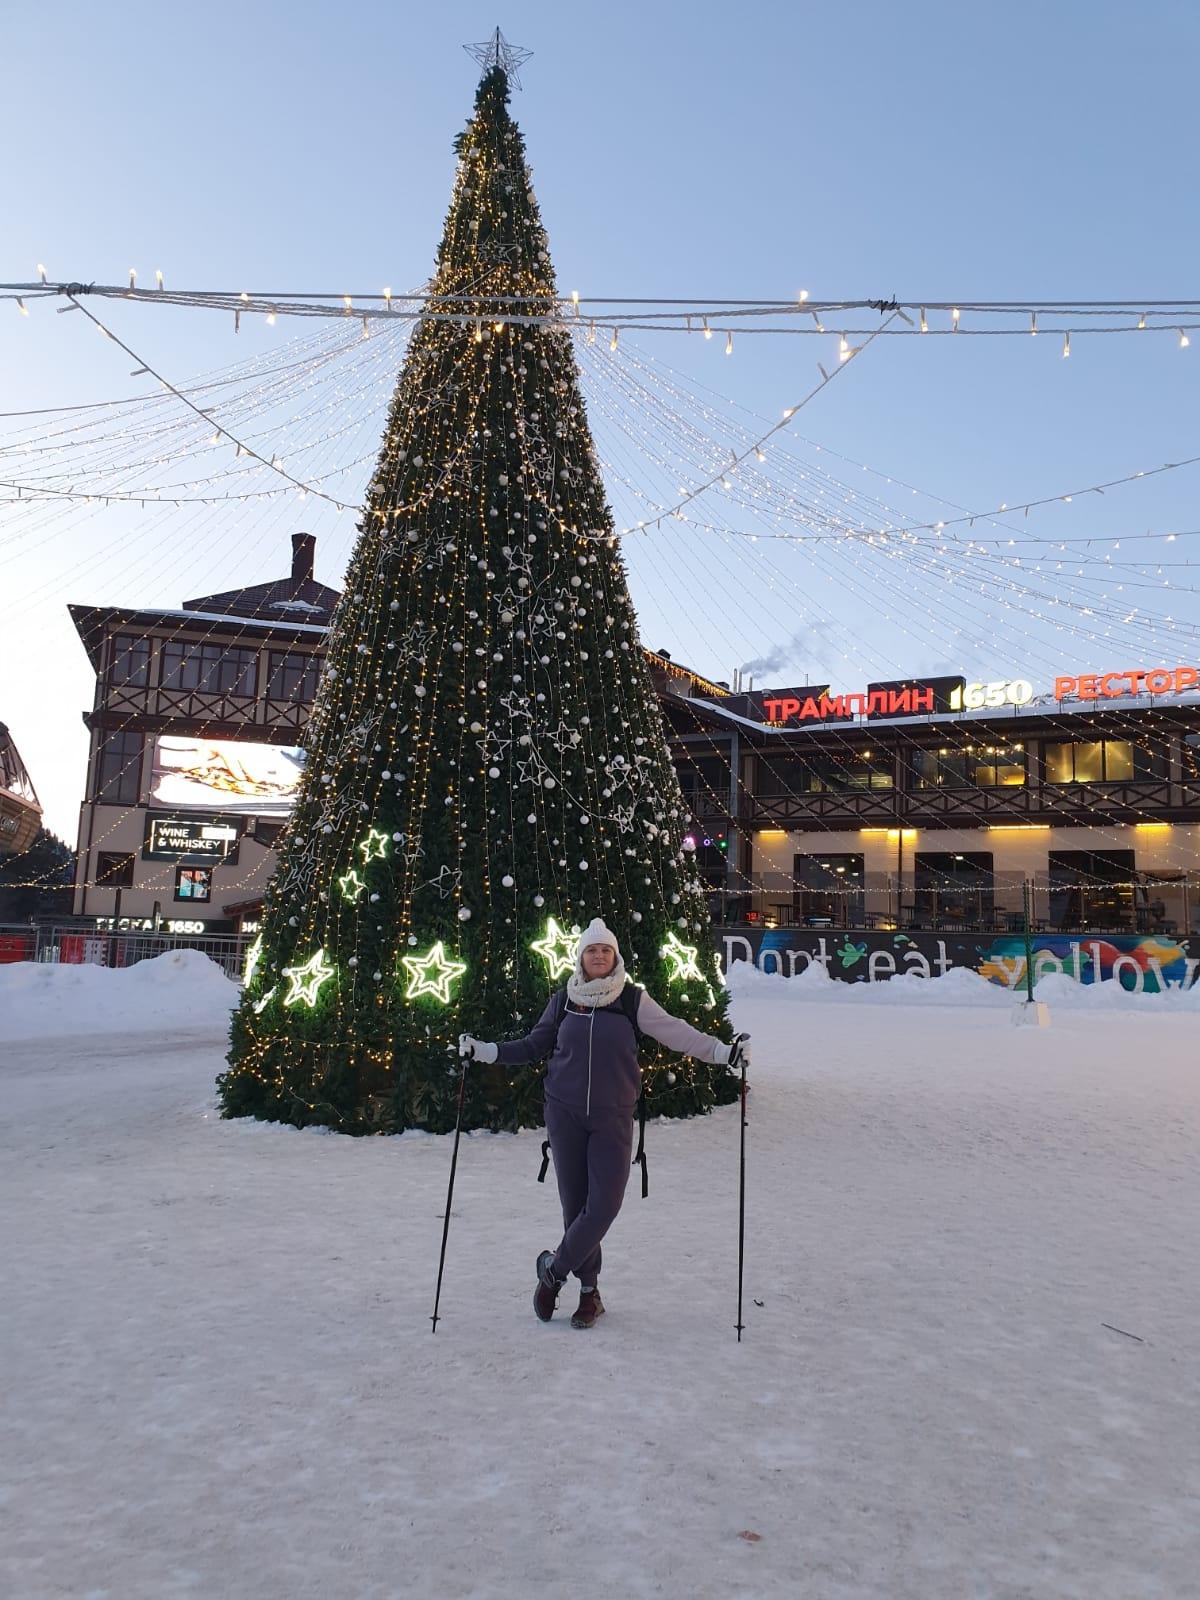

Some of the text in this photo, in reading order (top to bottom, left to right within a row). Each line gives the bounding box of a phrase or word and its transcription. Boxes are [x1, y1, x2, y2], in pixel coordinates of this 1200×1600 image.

[763, 667, 1200, 722] ТРАМПЛИН 1650 РЕСТОР
[159, 827, 190, 838] WINE
[157, 837, 221, 850] & WHISKEY
[167, 920, 205, 934] 1650
[868, 940, 953, 983] eat
